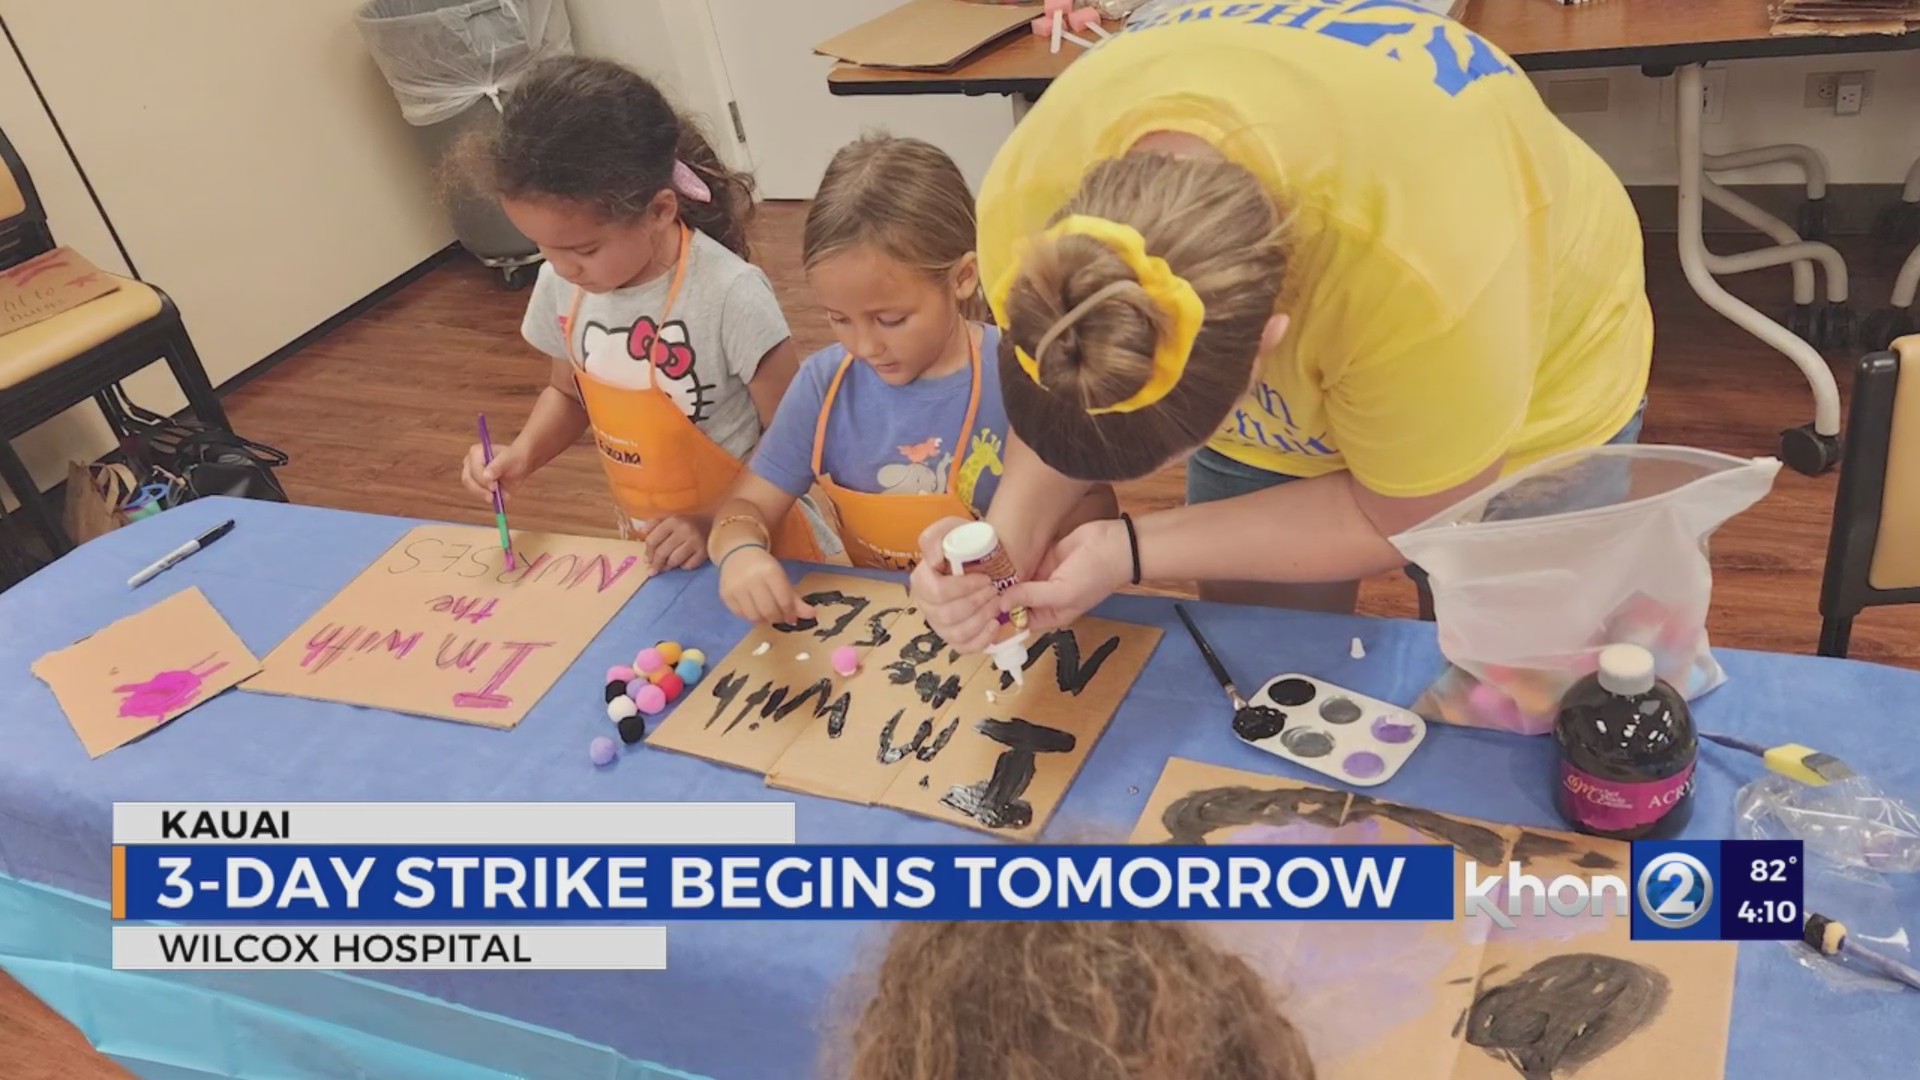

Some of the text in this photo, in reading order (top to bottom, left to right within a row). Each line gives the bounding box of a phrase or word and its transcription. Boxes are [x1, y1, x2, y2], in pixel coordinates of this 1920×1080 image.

[388, 538, 638, 593] NURSES
[425, 594, 500, 624] the
[300, 622, 424, 675] with
